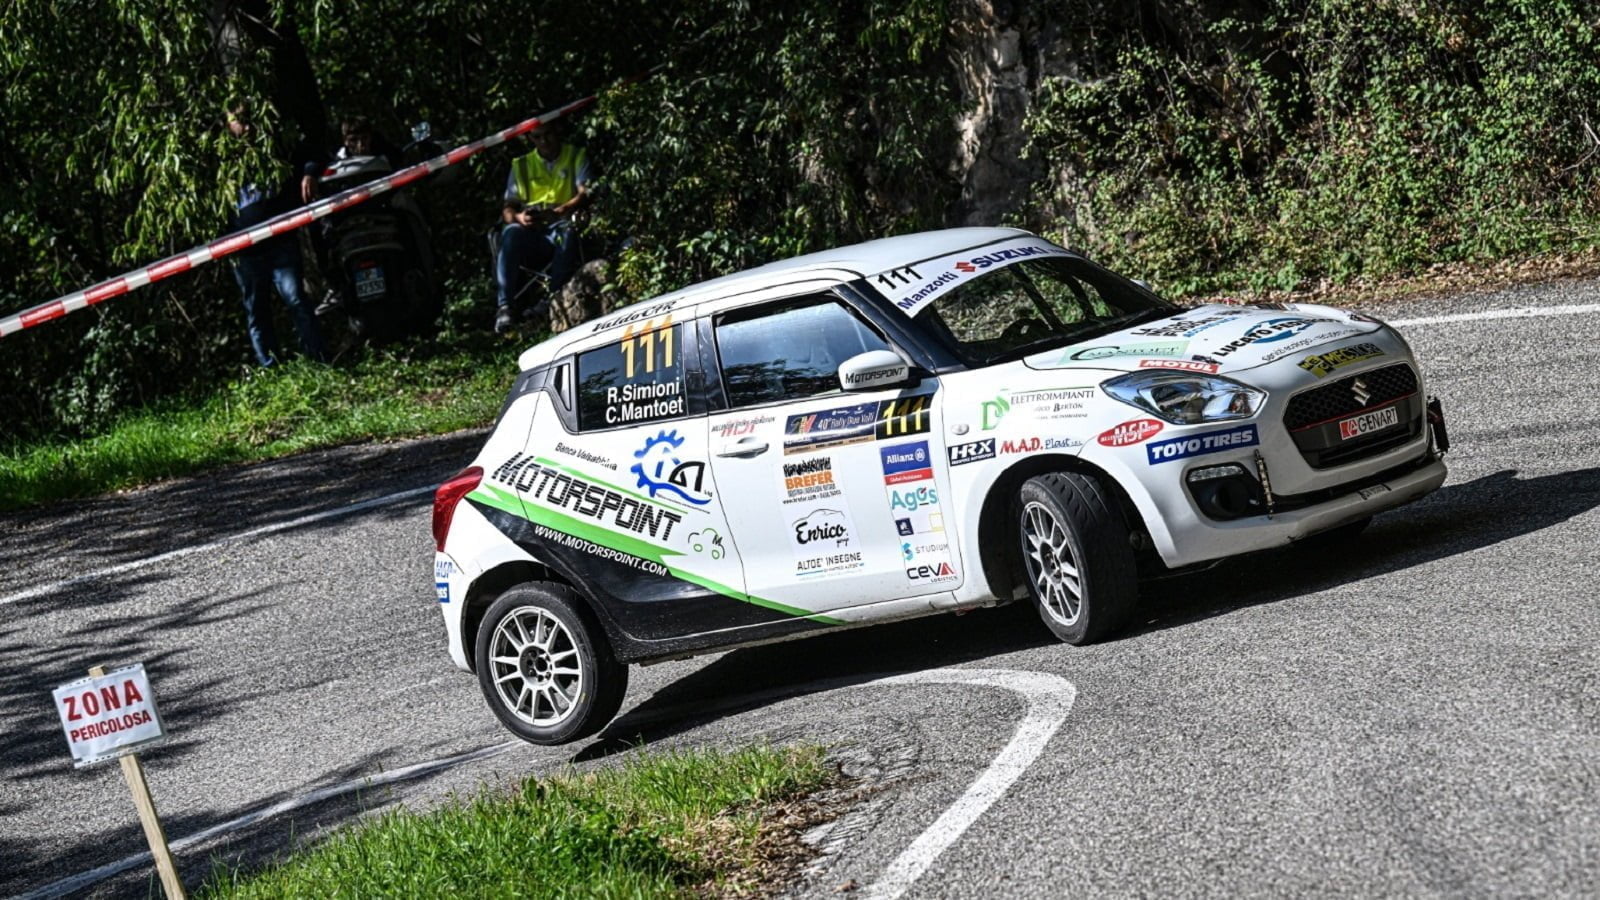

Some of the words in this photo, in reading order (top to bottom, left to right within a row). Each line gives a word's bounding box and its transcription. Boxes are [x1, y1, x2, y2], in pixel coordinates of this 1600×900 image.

[970, 246, 1049, 268] SUZUKI
[877, 265, 923, 290] 111
[897, 271, 959, 310] Manzotti
[621, 314, 673, 379] 111
[1213, 328, 1272, 357] LUCATO
[1145, 360, 1213, 372] MOTUL
[607, 377, 680, 404] R.Simioni
[1010, 390, 1095, 405] ELETTROIMPIANTI
[605, 397, 684, 423] C.Mantoet
[882, 397, 925, 436] 111
[951, 439, 994, 460] HRX
[1000, 437, 1044, 455] M.A.D.
[1152, 439, 1202, 460] TOYO
[1202, 430, 1253, 449] TIRES
[886, 455, 914, 464] Allianz
[784, 471, 834, 490] BREFER
[491, 451, 682, 541] MOTORSPOINT
[891, 487, 938, 511] Agos
[795, 521, 847, 545] Enrico
[534, 524, 667, 577] WWW.MOTORSPOINT.COM
[825, 551, 862, 566] INSEGNE
[915, 543, 949, 554] STUDIUM
[63, 679, 143, 721] ZONA
[70, 709, 152, 743] PERICOLOSA
